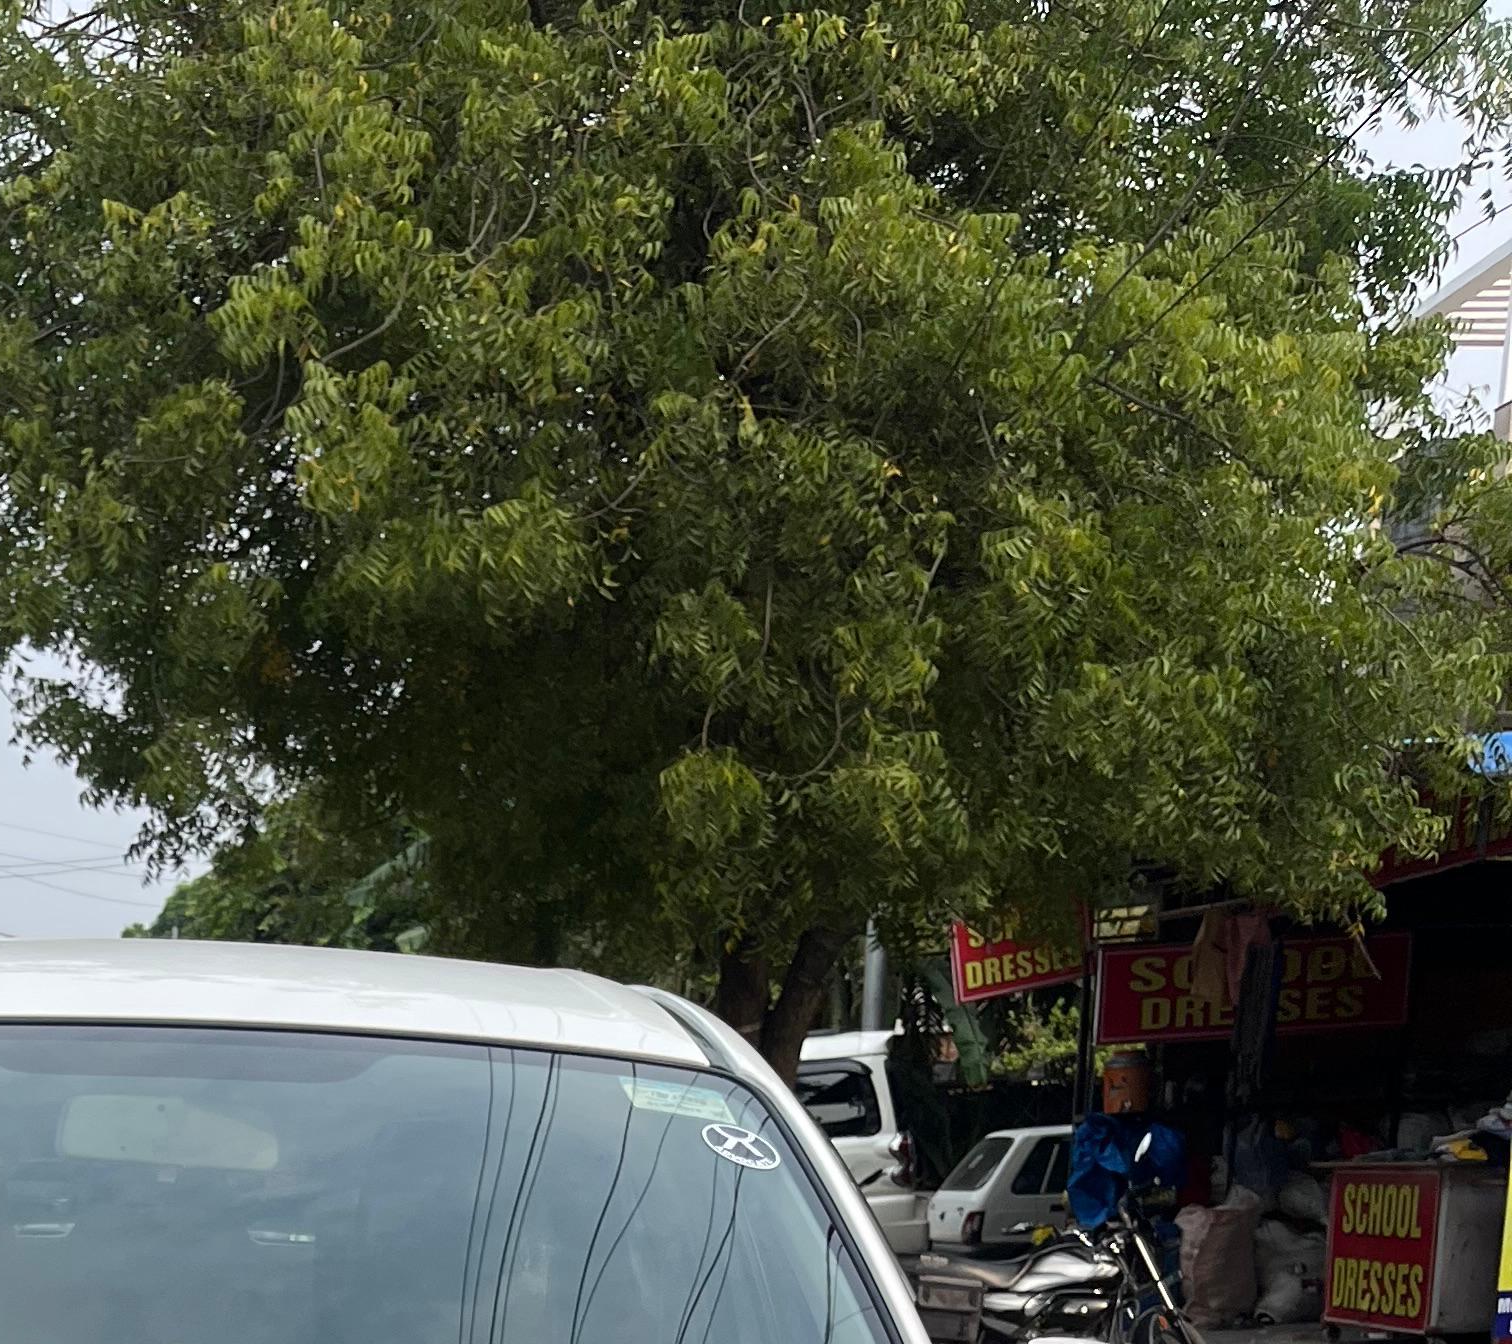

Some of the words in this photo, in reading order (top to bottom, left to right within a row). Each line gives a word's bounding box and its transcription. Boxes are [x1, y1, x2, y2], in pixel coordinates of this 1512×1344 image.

[1140, 985, 1366, 1031] DRESES
[1341, 1182, 1423, 1239] SCHOOL
[1331, 1257, 1424, 1319] DRESSES
